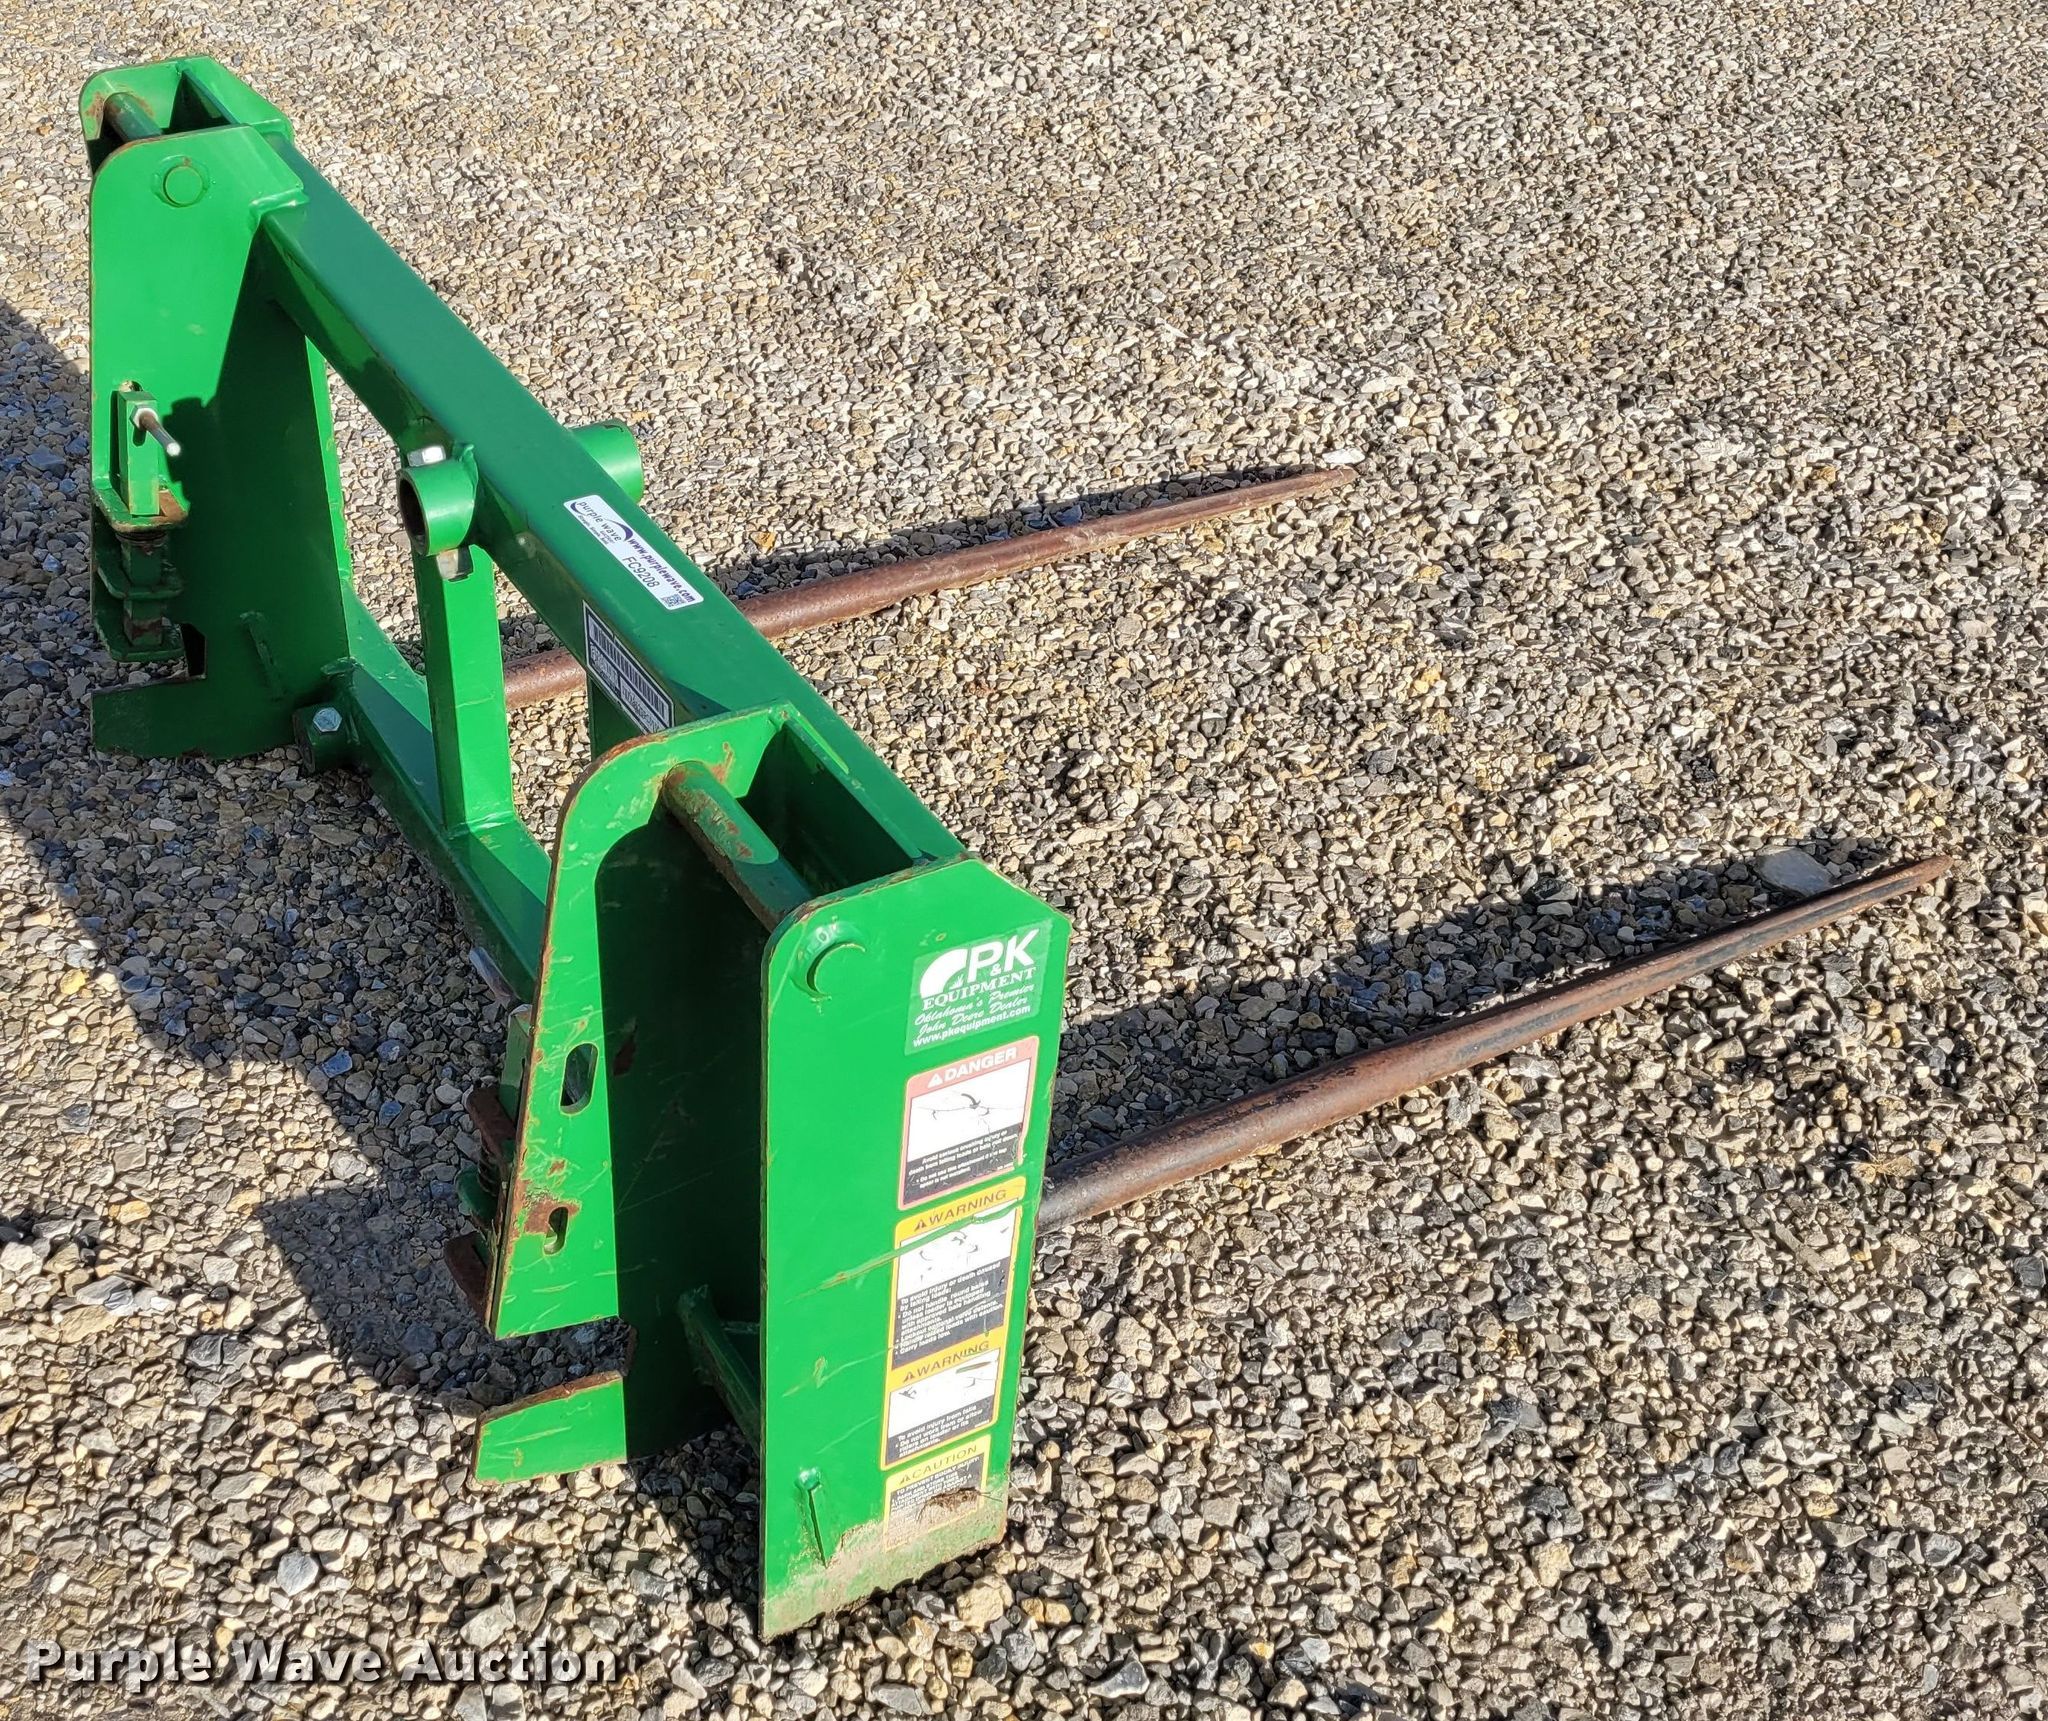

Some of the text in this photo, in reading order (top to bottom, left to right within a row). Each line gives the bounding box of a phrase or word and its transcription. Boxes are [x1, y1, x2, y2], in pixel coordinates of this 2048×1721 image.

[577, 502, 621, 541] purple wave
[622, 557, 660, 587] FC9208
[628, 539, 695, 602] www.purplewave.com
[915, 985, 1034, 1025] Oklahoma's Premier
[923, 967, 1036, 1010] EQUIPMENT
[913, 1005, 1031, 1047] www.pkequipment.com
[917, 997, 1028, 1040] John Deere Dealer
[944, 1047, 1017, 1082] DANGER
[929, 1190, 1006, 1225] WARNING
[917, 1341, 990, 1377] WARNING
[913, 1445, 977, 1479] CAUTION
